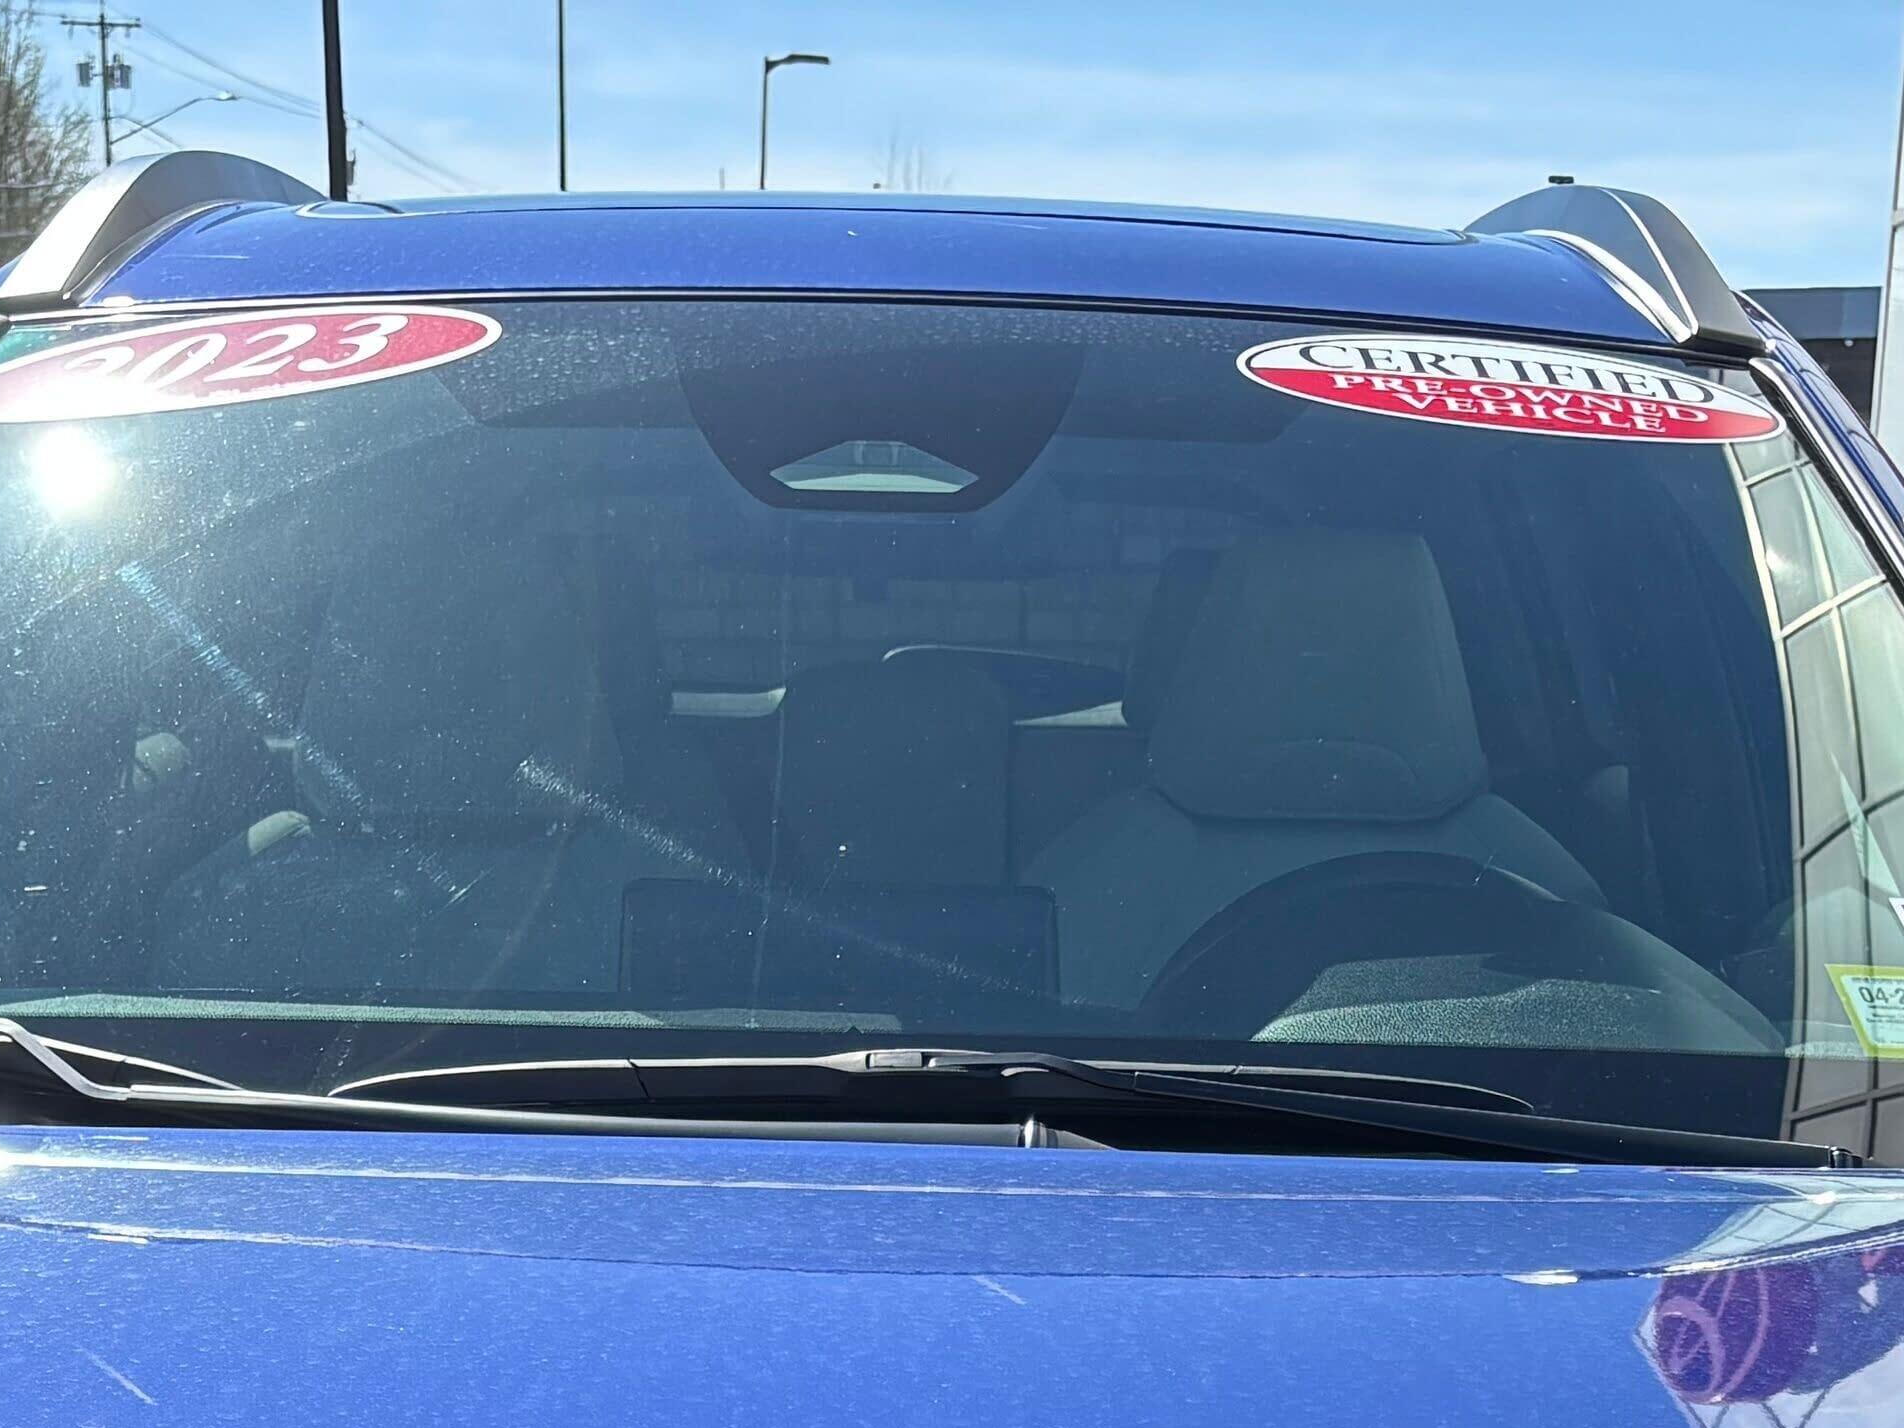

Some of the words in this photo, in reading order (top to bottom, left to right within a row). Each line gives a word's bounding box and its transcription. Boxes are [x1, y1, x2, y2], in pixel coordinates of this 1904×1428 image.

[1298, 343, 1715, 403] CERTIFIED
[1334, 374, 1709, 424] PRE-OWNED
[1397, 393, 1667, 433] VEHICLE
